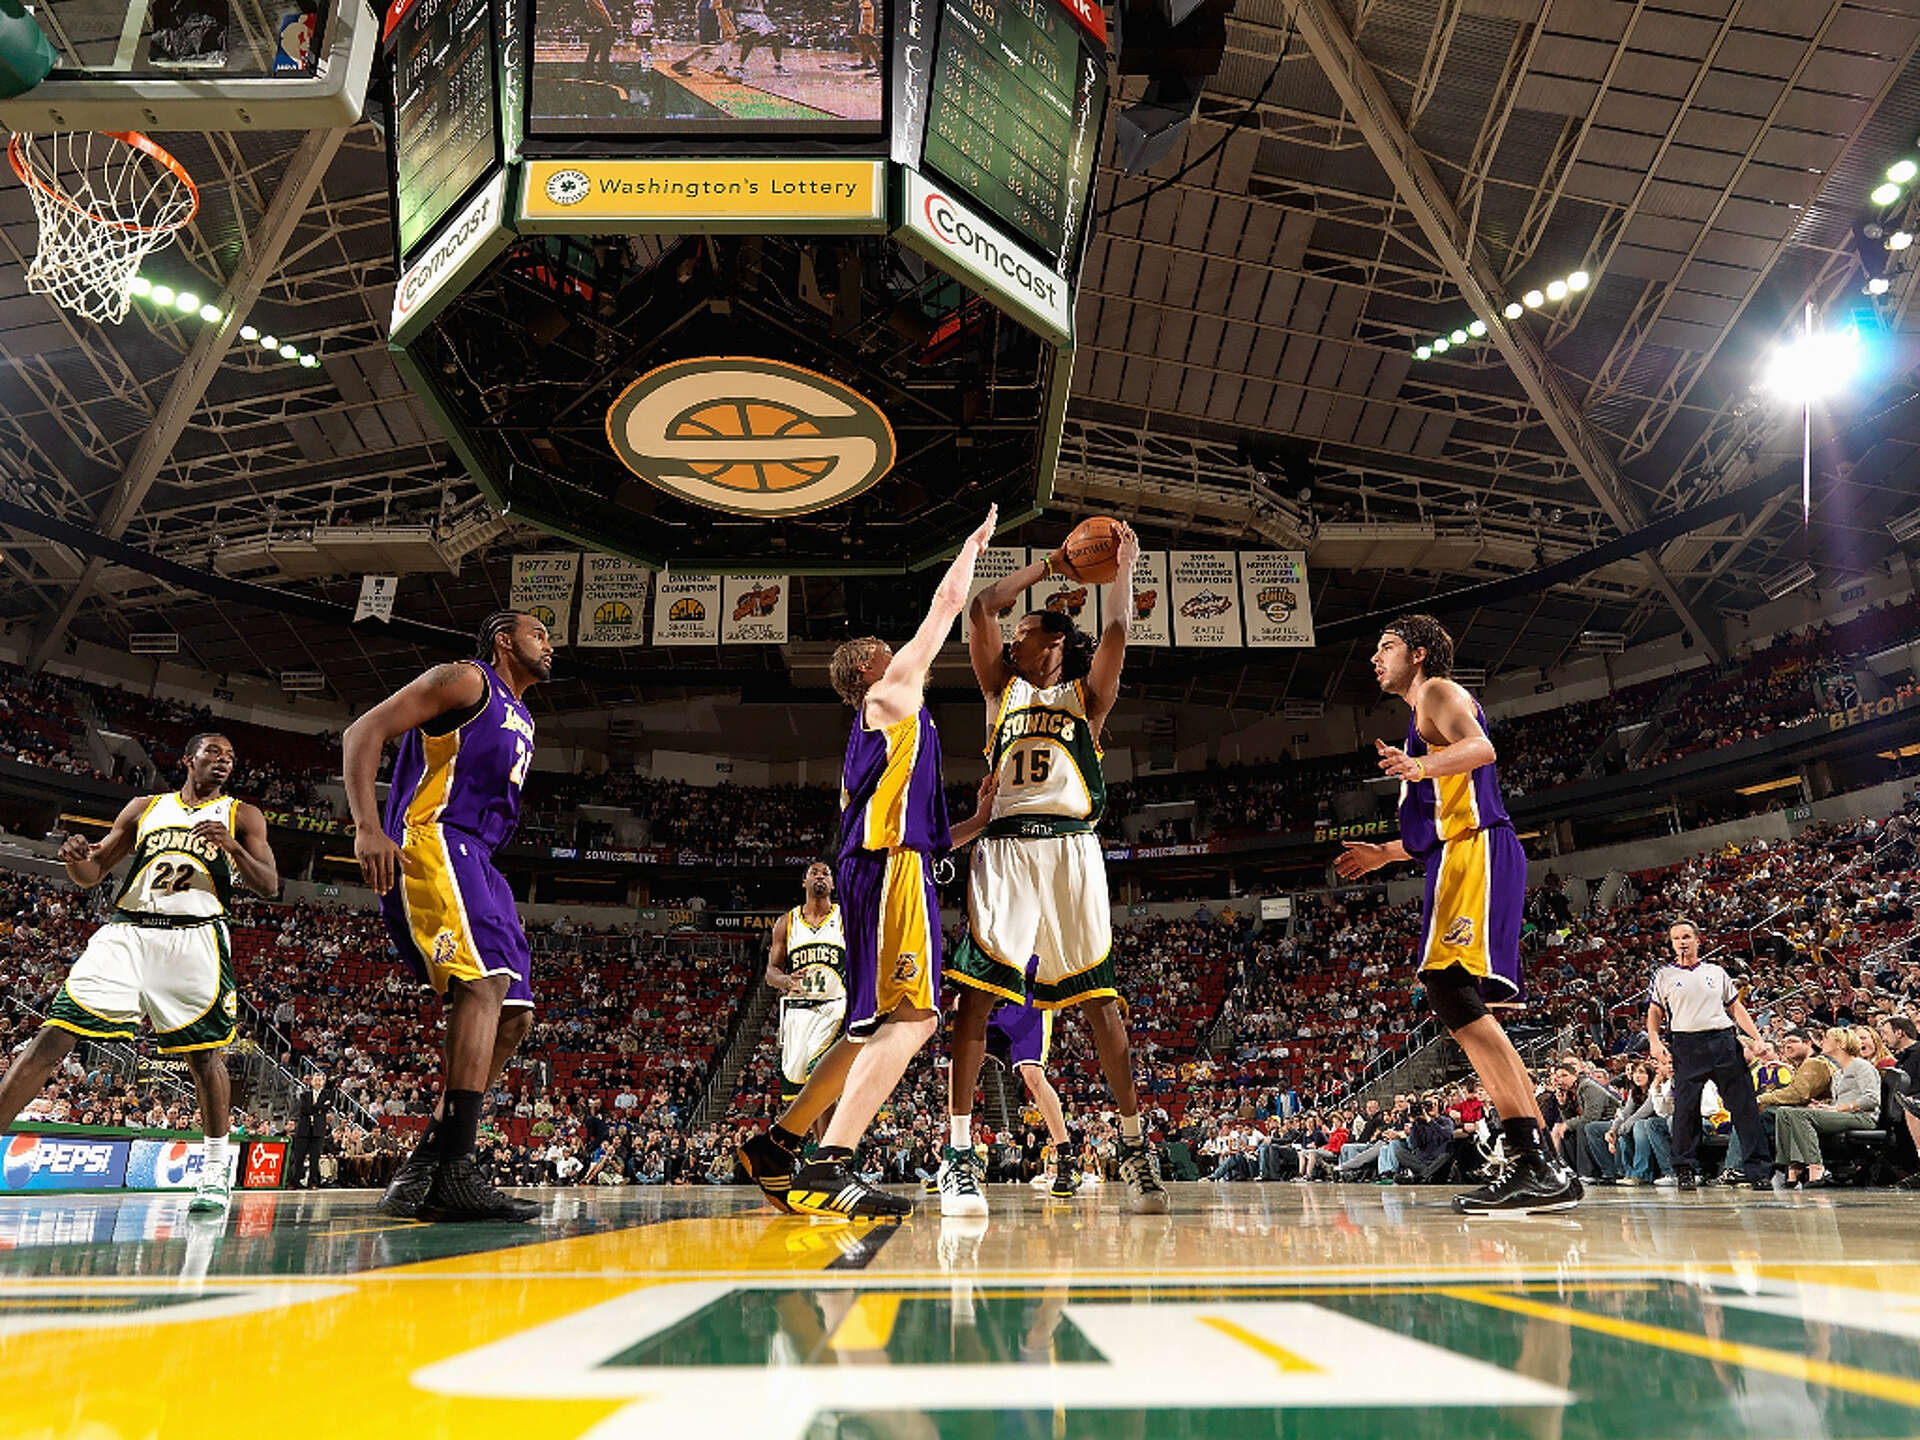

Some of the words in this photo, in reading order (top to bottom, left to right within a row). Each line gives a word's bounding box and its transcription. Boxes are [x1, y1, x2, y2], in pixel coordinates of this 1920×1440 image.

[599, 177, 759, 198] Washington's
[771, 177, 858, 198] Lottery
[1000, 711, 1076, 745] SONICS
[1011, 748, 1053, 787] 15
[296, 816, 339, 834] THE
[1313, 820, 1388, 843] BEFORE
[145, 830, 220, 861] SONICS
[151, 861, 197, 892] 22
[715, 917, 741, 927] OUR
[791, 946, 839, 967] SONICS
[801, 970, 826, 992] 44
[31, 1142, 114, 1174] PEPSI
